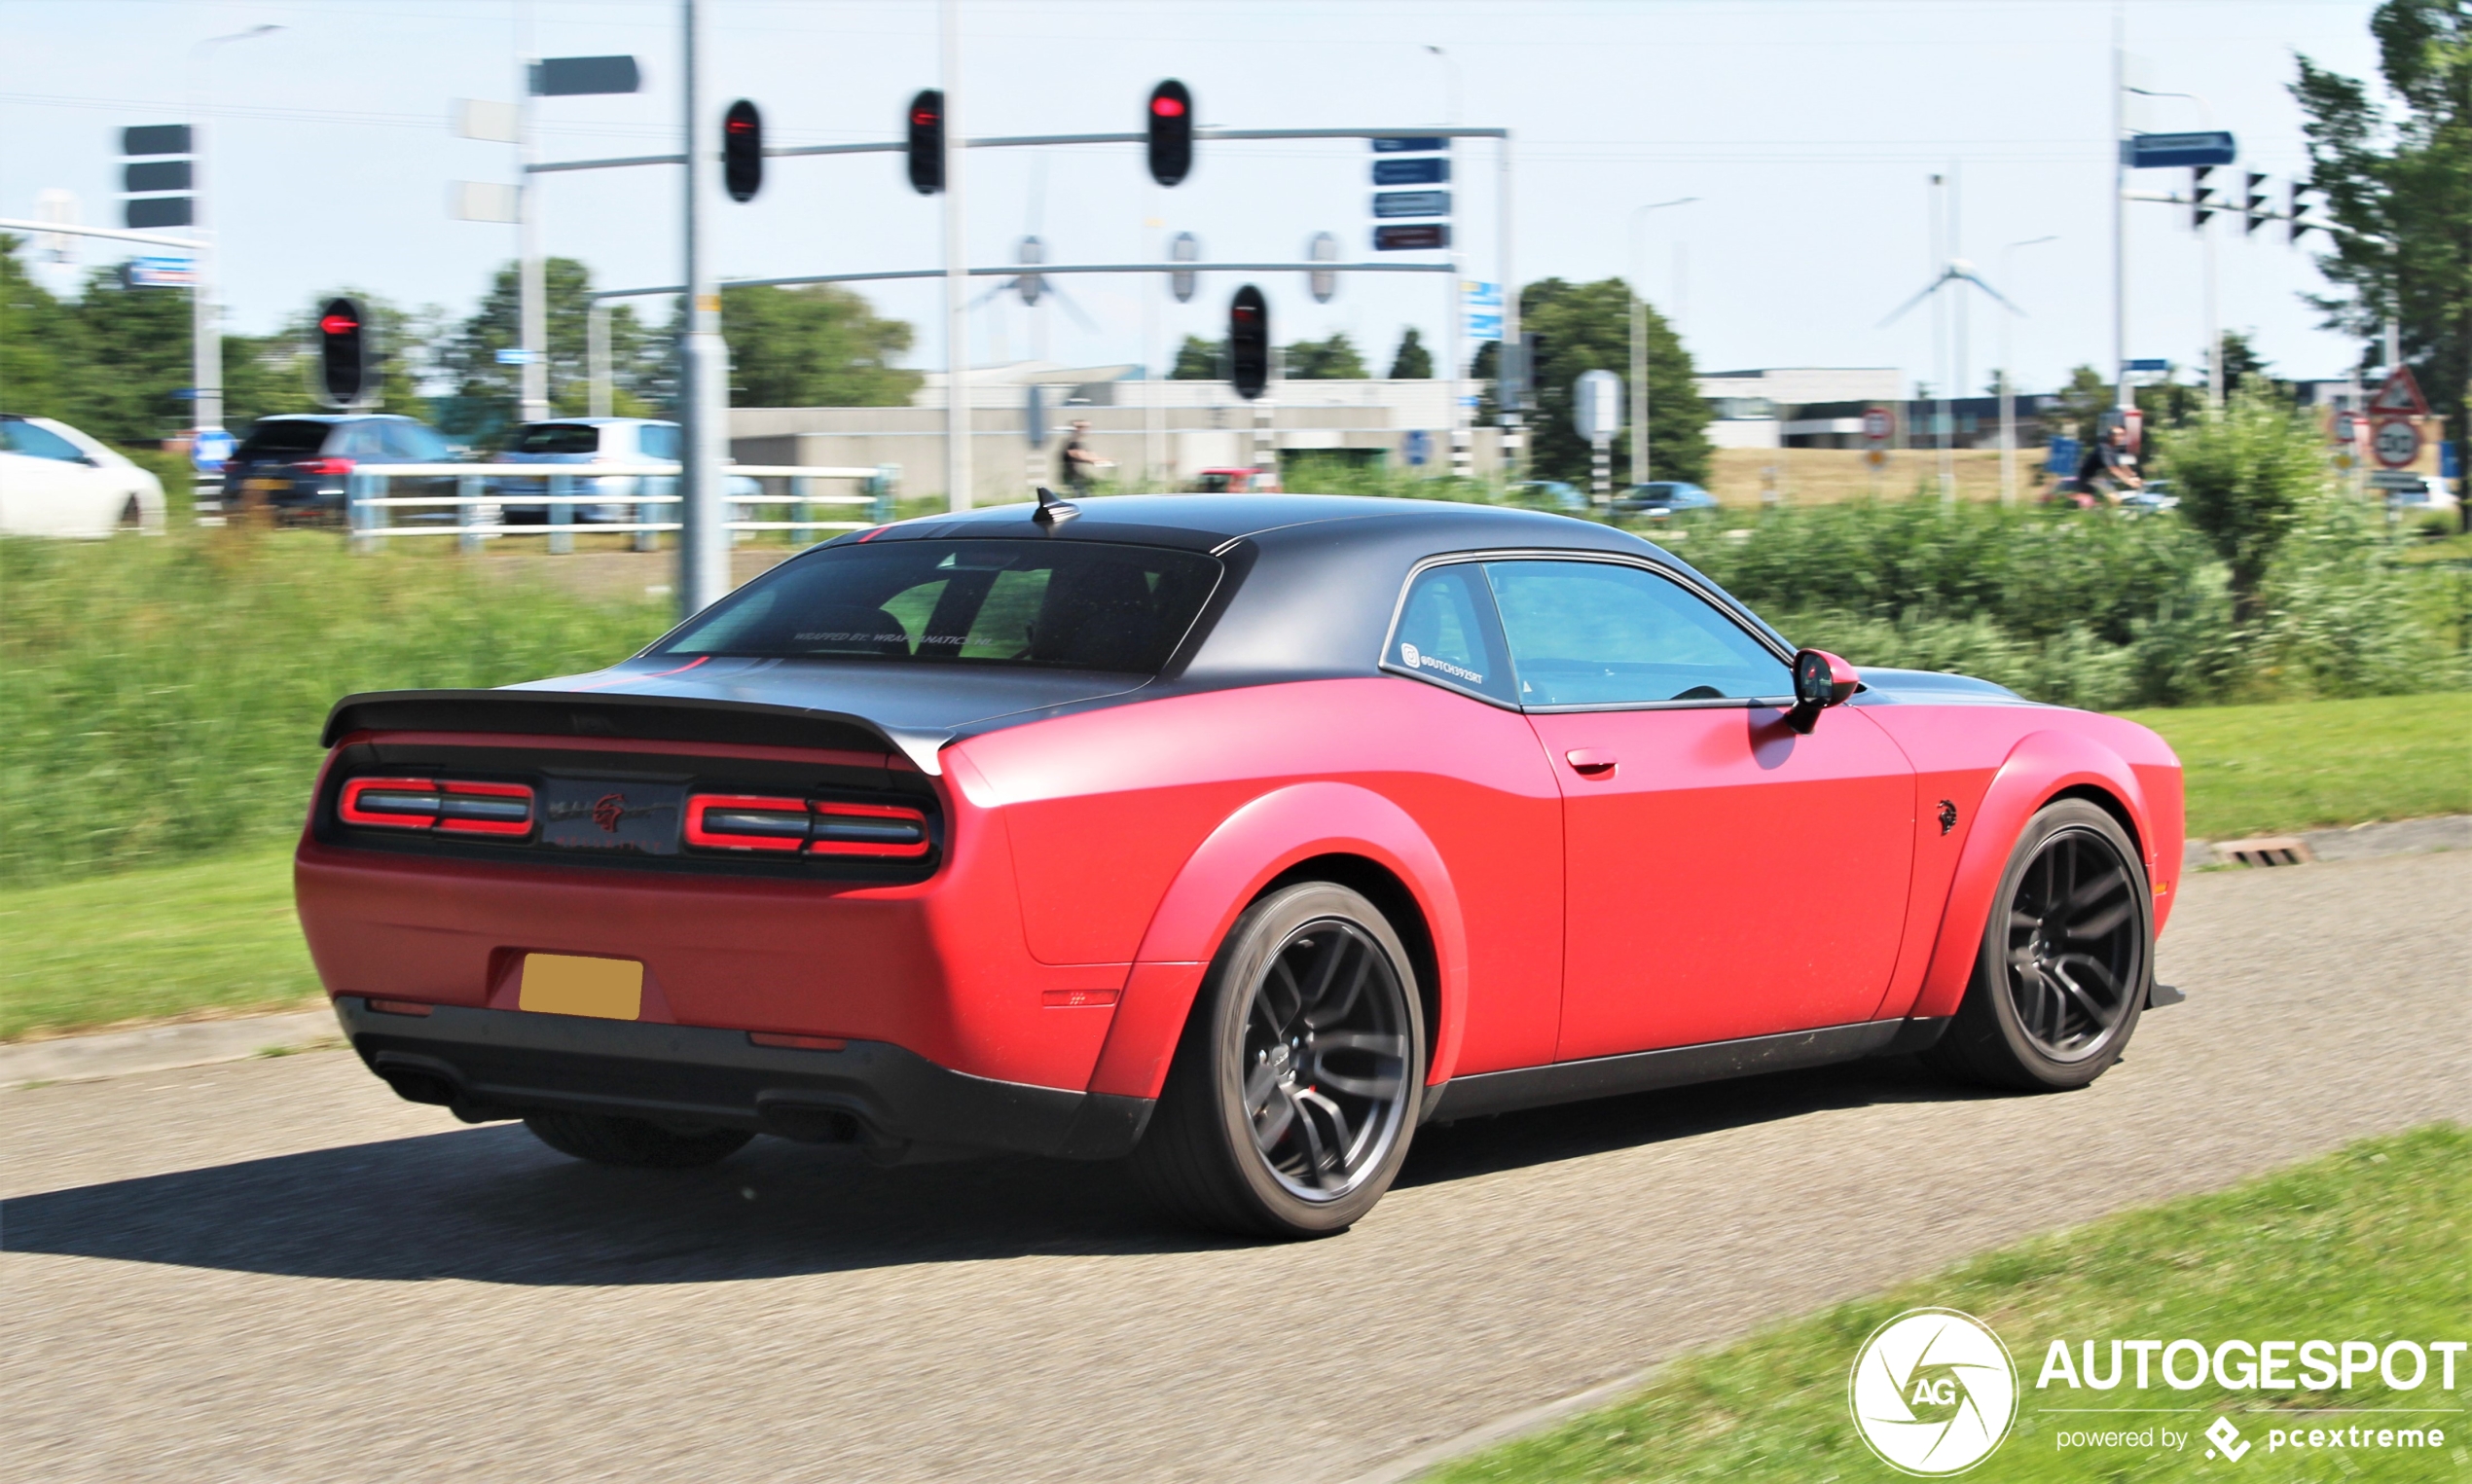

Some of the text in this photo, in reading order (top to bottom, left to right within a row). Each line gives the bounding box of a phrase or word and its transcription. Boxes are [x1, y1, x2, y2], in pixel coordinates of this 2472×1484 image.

[793, 633, 849, 642] WRAPPED
[849, 633, 867, 641] BY:
[1420, 655, 1483, 684] @DUTCH392SRT
